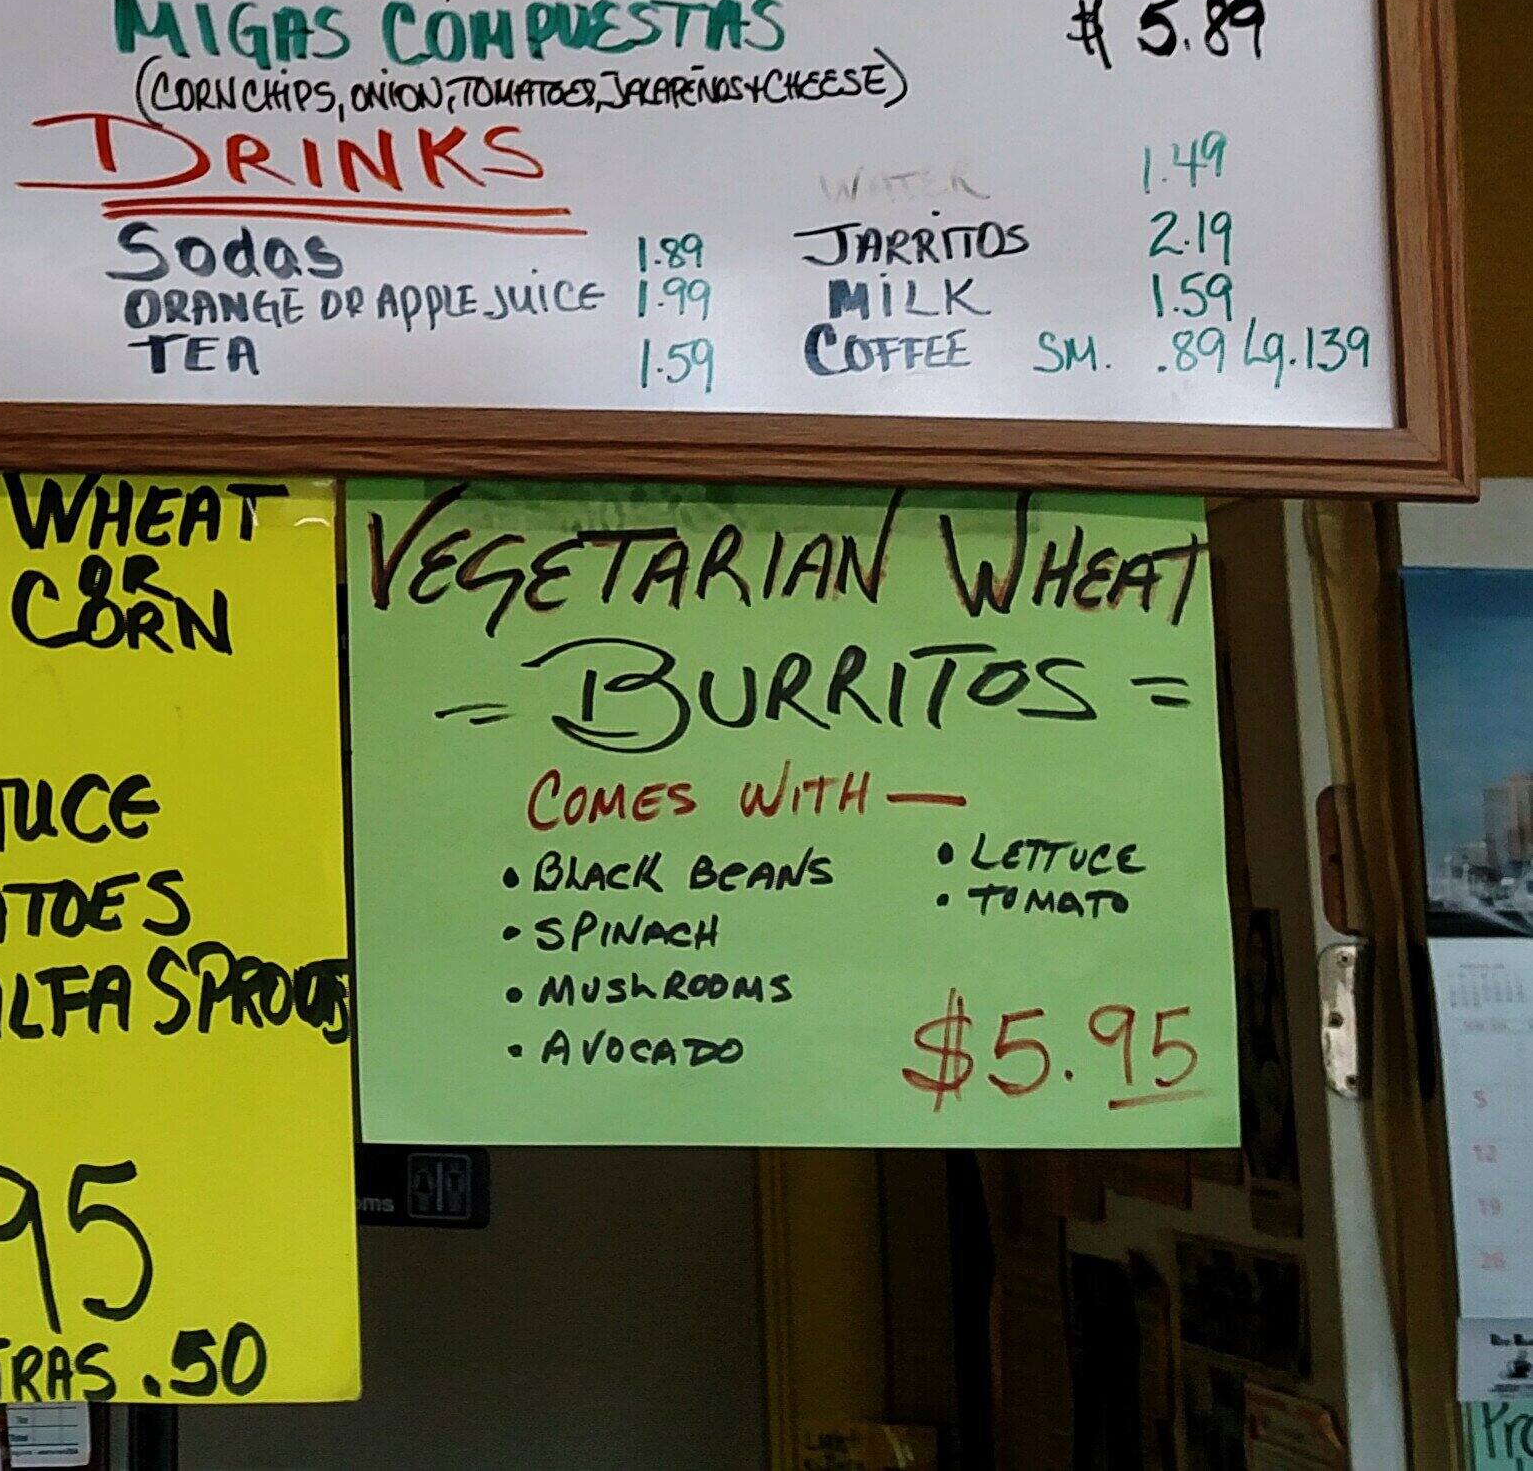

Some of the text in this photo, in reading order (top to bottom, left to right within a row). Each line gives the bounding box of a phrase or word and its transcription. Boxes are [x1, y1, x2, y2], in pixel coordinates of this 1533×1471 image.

[383, 0, 785, 65] COMPUESTAS
[15, 113, 545, 192] DRINKS
[1141, 130, 1227, 193] 1.49
[105, 221, 344, 282] Sodas
[639, 233, 704, 273] 1.89
[793, 210, 1030, 267] JARRITOS
[1148, 210, 1232, 266] 2.19
[124, 288, 305, 328] ORANGE
[376, 282, 477, 333] APPLE
[636, 278, 711, 321] 1.99
[829, 276, 991, 321] MILK
[1151, 273, 1232, 324] 1.59
[127, 334, 259, 376] TEA
[639, 337, 714, 394] 1.59
[804, 324, 970, 379] COFFEE
[3, 471, 288, 548] WHEAT
[77, 554, 174, 596] OR
[367, 486, 1208, 635] VEGETARIAN WHEAT
[11, 567, 231, 655] CORN
[522, 637, 1098, 753] BURRITOS
[527, 760, 869, 830] COMES WITH
[533, 846, 835, 894] BLACK BEANS
[971, 835, 1147, 876] LETTUCE
[968, 886, 1129, 916] TOMATO
[535, 914, 718, 952] SPINACH
[538, 971, 793, 1006] MUSHROOMS
[541, 1034, 743, 1067] AVOCADO
[901, 988, 1201, 1112] $5.95
[140, 1322, 267, 1399] .50
